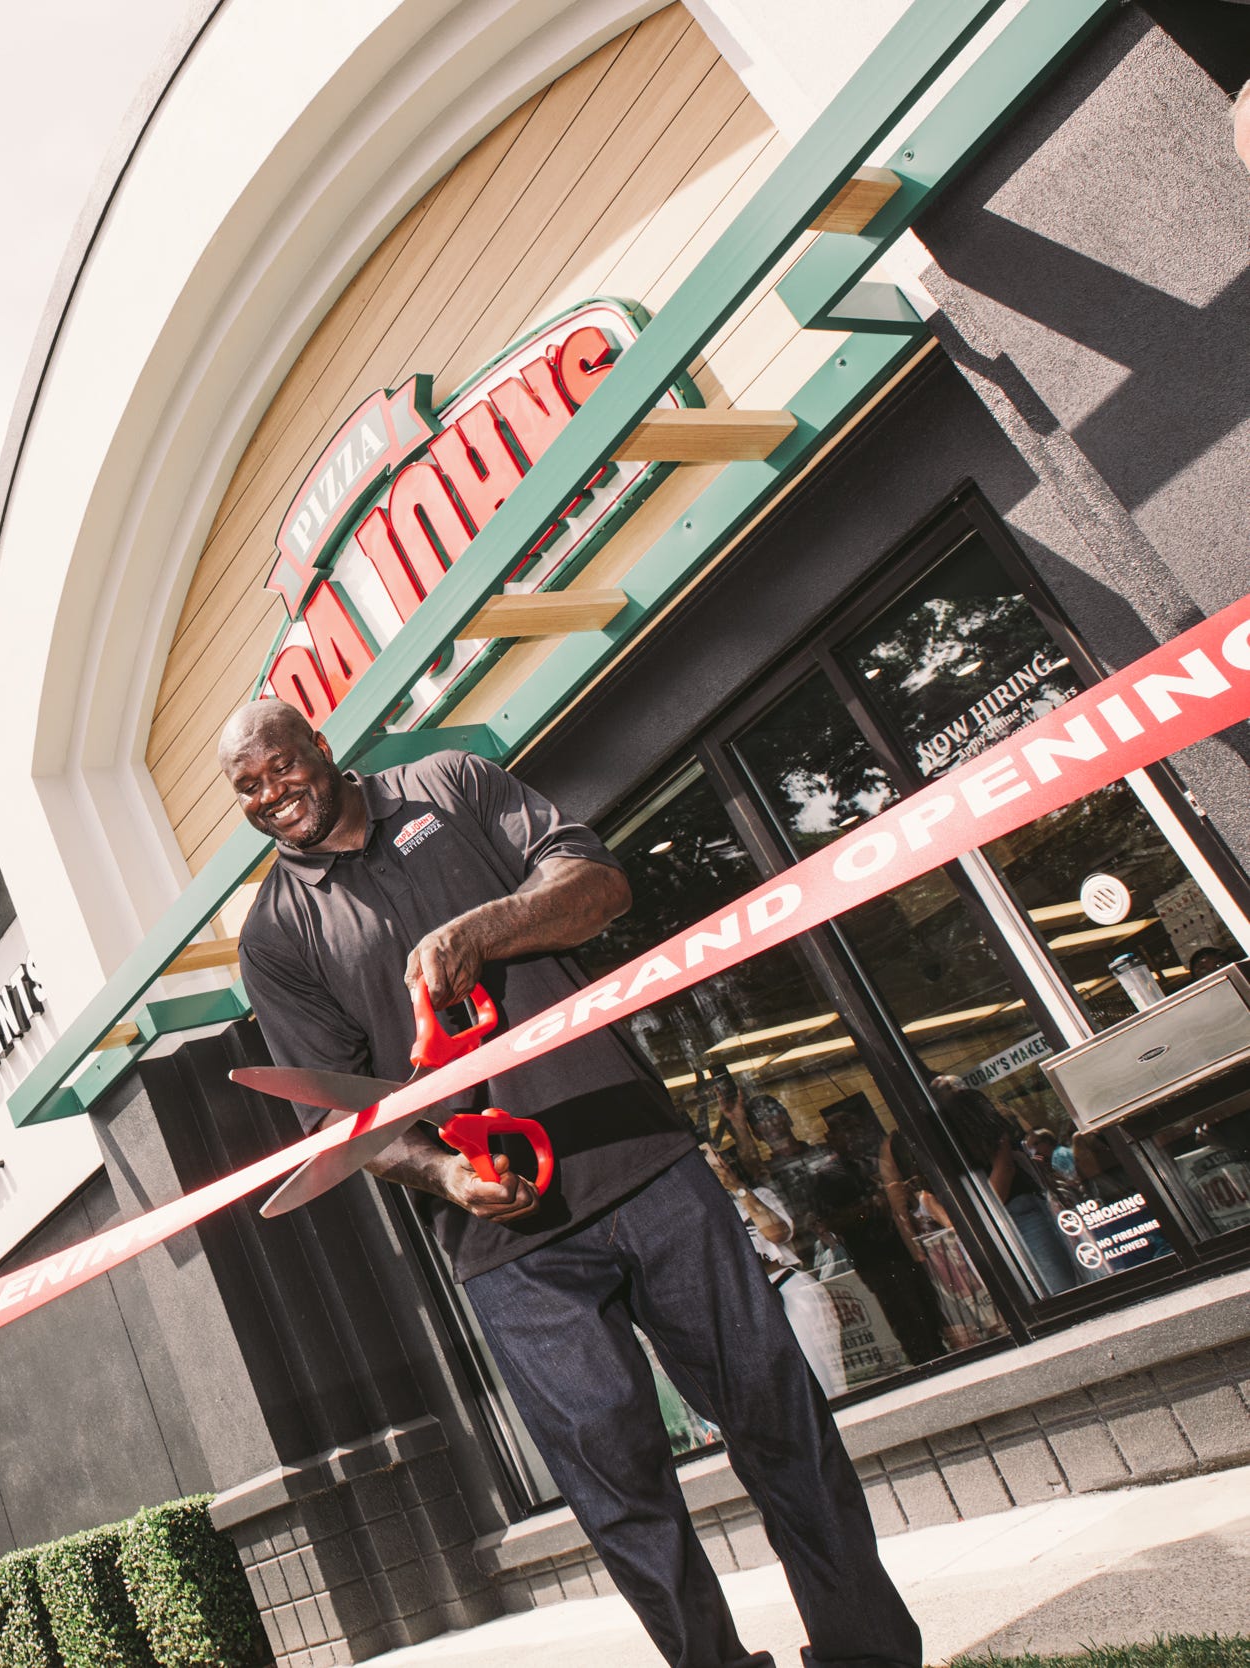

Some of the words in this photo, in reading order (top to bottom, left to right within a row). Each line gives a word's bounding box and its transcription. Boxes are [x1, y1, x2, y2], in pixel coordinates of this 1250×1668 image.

[290, 423, 385, 555] PIZZA
[916, 714, 970, 767] NOW
[968, 654, 1053, 724] HIRING
[958, 734, 986, 759] Apply
[985, 709, 1021, 737] Online
[1020, 698, 1034, 713] At
[395, 830, 412, 846] PAPA
[512, 884, 803, 1052] GRAND
[962, 1056, 1010, 1087] TODAY'S
[1076, 1199, 1099, 1216] NO
[1082, 1193, 1147, 1227] SMOKING
[1096, 1237, 1113, 1250] NO
[1111, 1218, 1161, 1244] FIREARMS
[1103, 1237, 1149, 1261] ALLOWED
